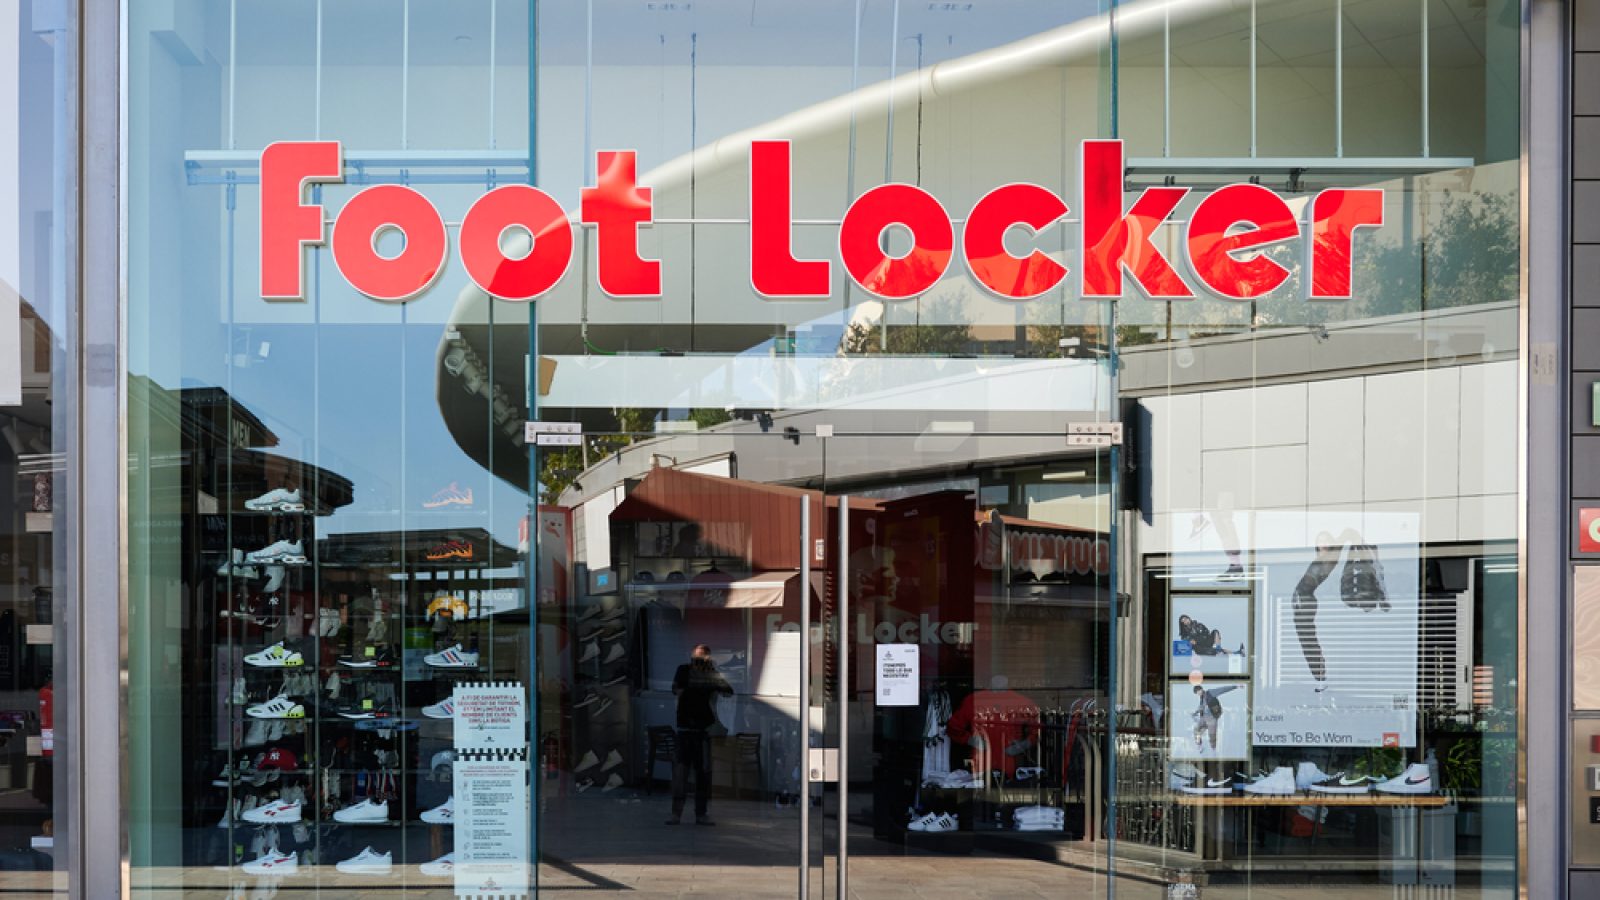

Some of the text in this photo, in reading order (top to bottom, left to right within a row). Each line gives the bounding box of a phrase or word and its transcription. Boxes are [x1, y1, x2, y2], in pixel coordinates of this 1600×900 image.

[259, 139, 1385, 303] Foot Locker
[856, 613, 979, 645] Locker
[1256, 732, 1287, 744] Yours
[1288, 732, 1302, 744] To
[1305, 732, 1321, 744] Be
